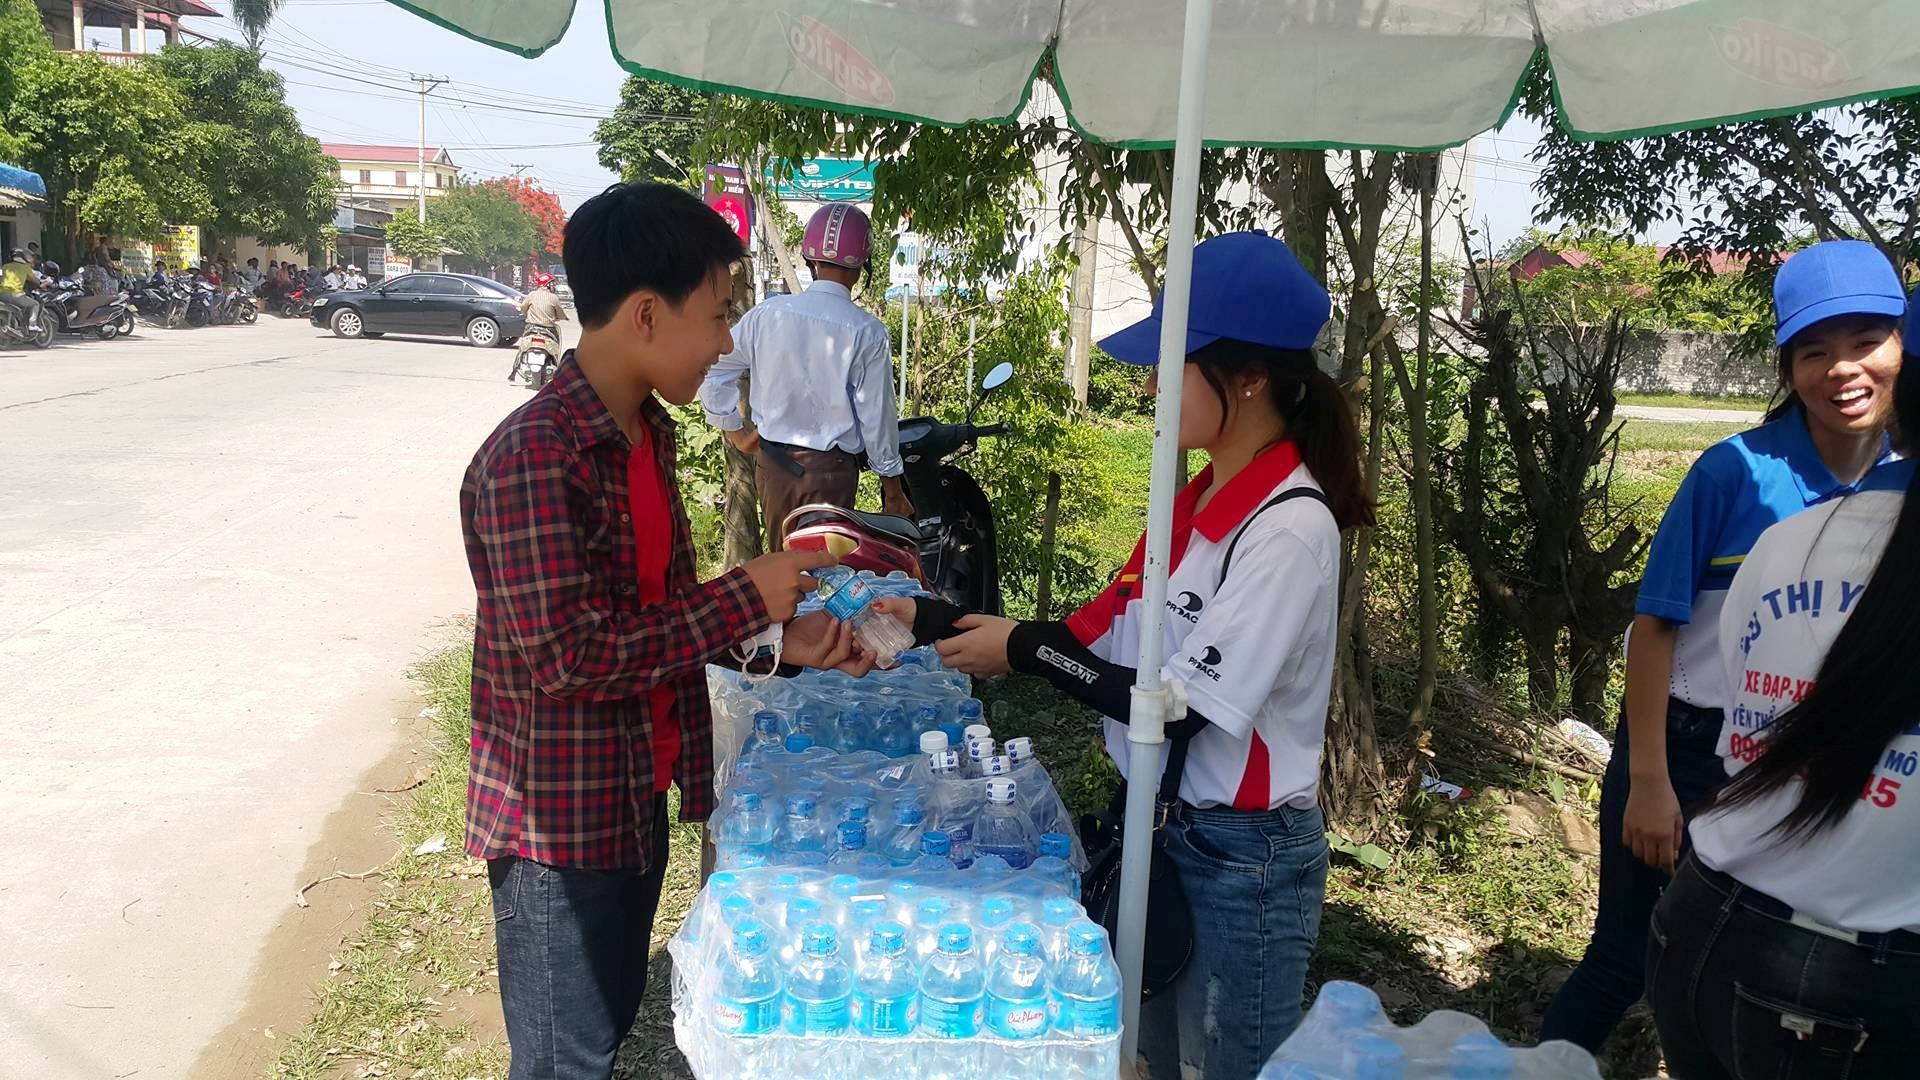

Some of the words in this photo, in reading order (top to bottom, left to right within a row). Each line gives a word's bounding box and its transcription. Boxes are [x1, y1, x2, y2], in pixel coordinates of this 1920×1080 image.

[800, 178, 873, 190] VIETTEL
[1761, 580, 1823, 620] THỊ
[1048, 652, 1100, 685] SCOTT
[1744, 669, 1760, 694] XE
[1733, 703, 1752, 729] YÊN
[1884, 749, 1918, 776] MÔ
